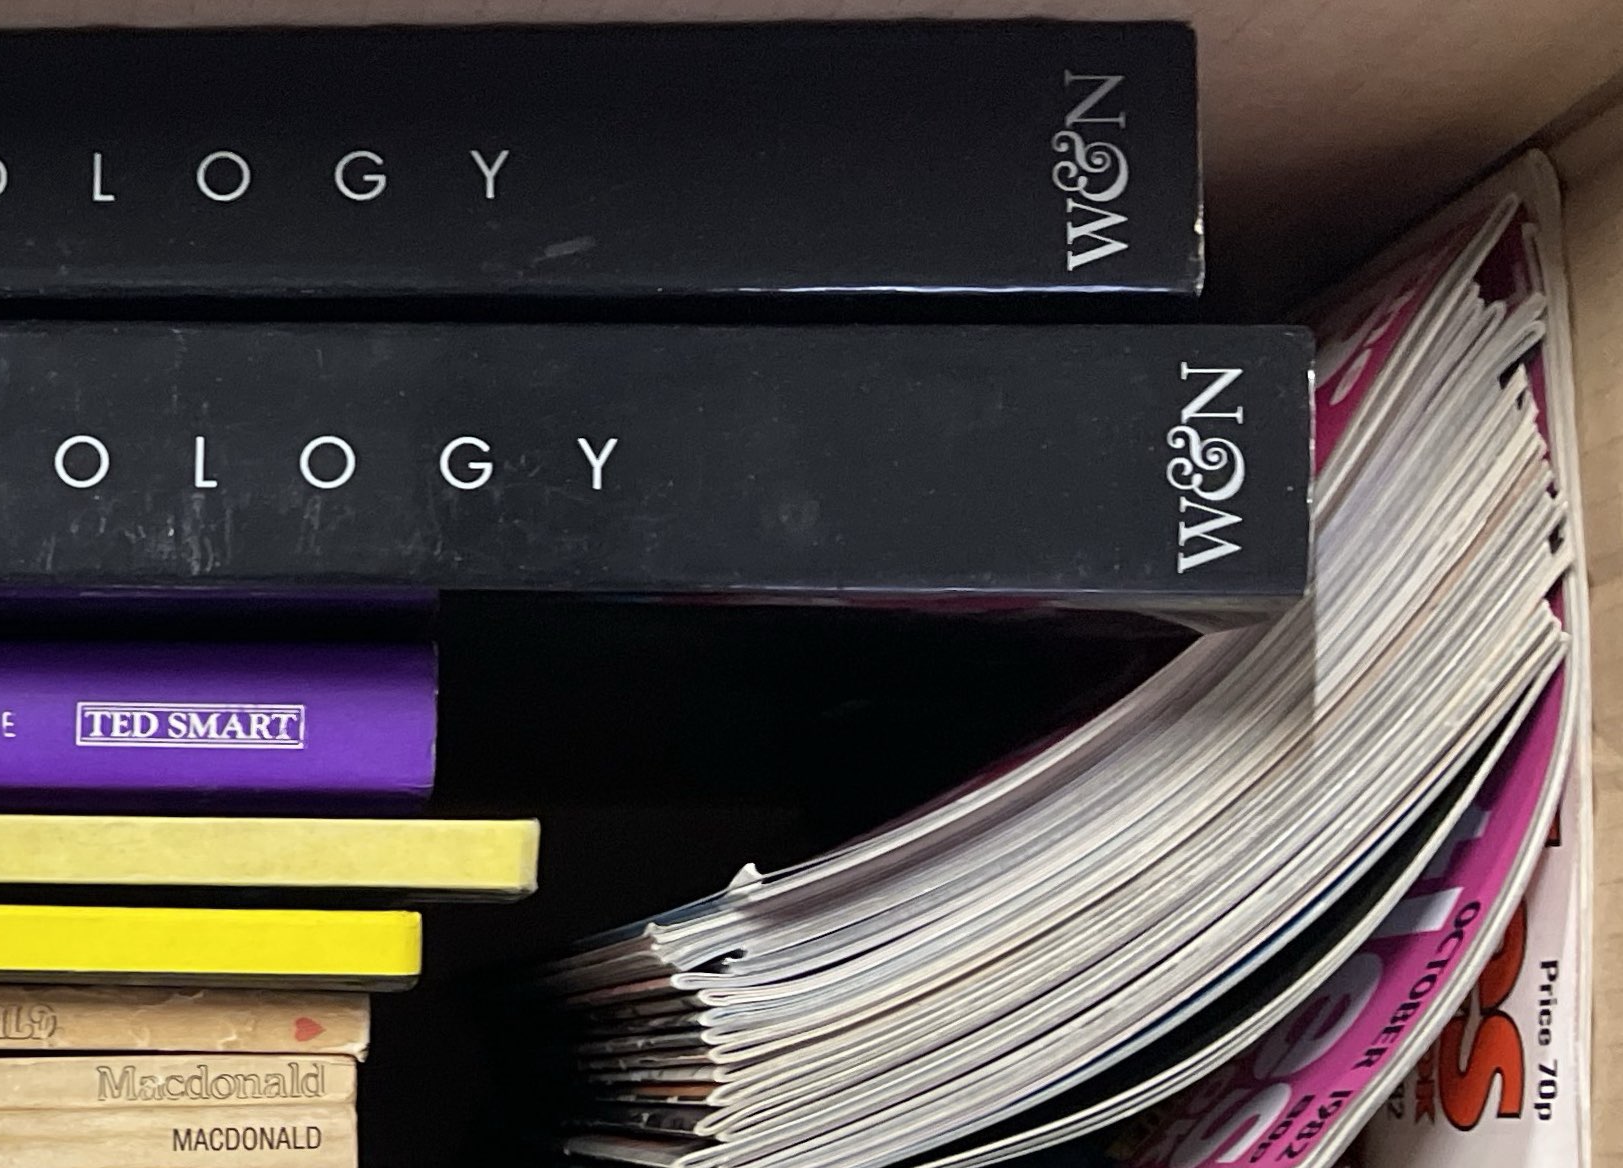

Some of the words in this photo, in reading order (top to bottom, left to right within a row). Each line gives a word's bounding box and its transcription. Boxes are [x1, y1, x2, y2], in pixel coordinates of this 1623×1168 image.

[1052, 69, 1129, 271] W&N
[1167, 362, 1245, 574] W&N
[84, 711, 159, 740] TED
[167, 711, 299, 742] SMART
[1353, 900, 1482, 1070] OCTOBER
[1537, 960, 1560, 1046] Price
[96, 1062, 327, 1103] Macdonald
[1533, 1059, 1559, 1121] 70p
[171, 1126, 323, 1153] MACDONALD
[1274, 1089, 1354, 1162] 1982
